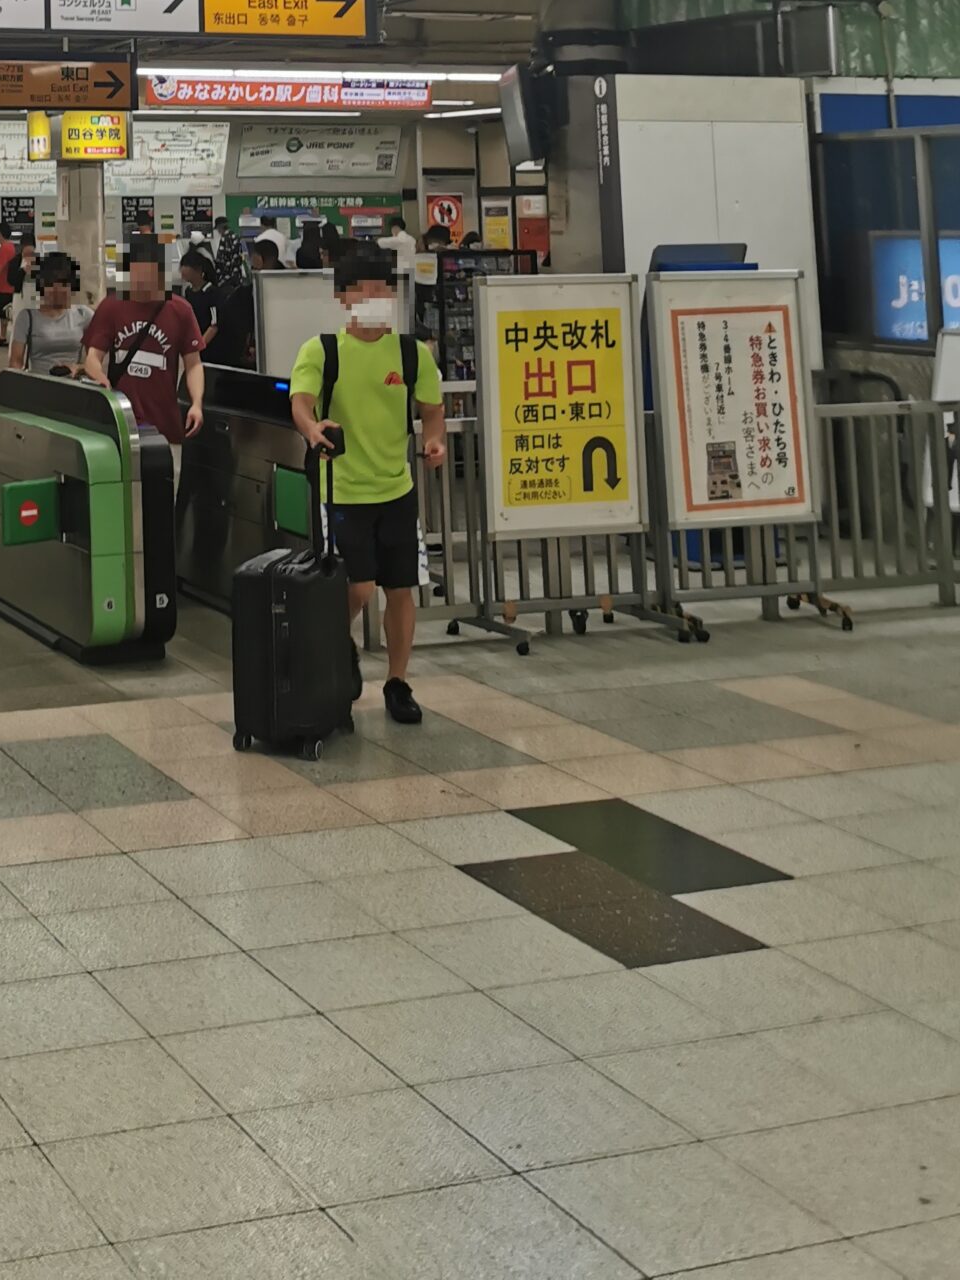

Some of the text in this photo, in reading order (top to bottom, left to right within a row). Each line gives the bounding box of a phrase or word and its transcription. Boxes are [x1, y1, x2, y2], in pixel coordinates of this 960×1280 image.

[213, 12, 248, 25] 东出口
[61, 66, 89, 81] 東口
[51, 84, 89, 93] East Exit
[177, 82, 339, 102] みなみかしわ駅ノ歯科
[68, 127, 121, 141] 四谷学院
[505, 320, 616, 352] 中央改札
[524, 357, 597, 401] 出口
[748, 334, 775, 486] 特急券お買い求めの
[767, 336, 789, 468] ときわ・ひたち号
[514, 433, 563, 452] 南口は
[741, 409, 761, 491] お客さまへ
[508, 455, 570, 475] 反対です
[520, 478, 560, 489] 連絡通路を
[514, 489, 567, 501] ご利用ください
